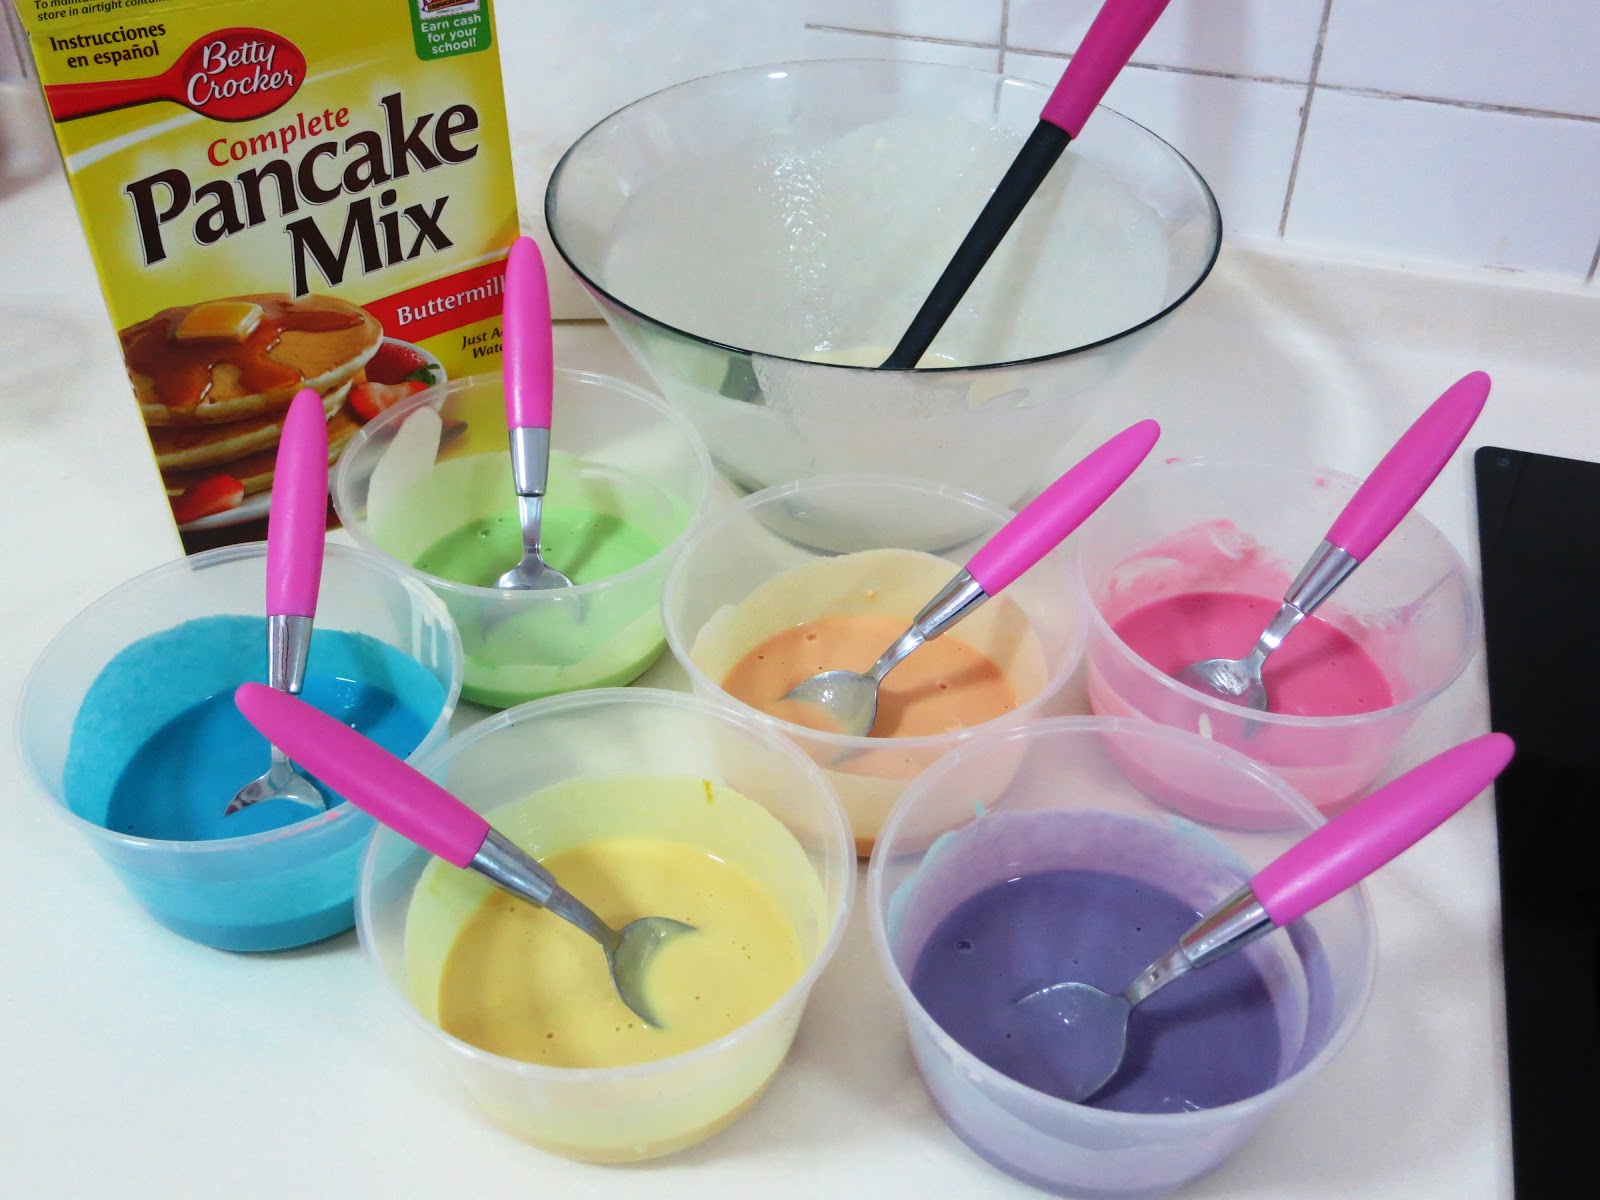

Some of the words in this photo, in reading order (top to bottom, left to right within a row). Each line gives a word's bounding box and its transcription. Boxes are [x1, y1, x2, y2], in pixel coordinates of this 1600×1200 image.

[34, 0, 48, 10] To
[37, 10, 67, 22] store
[69, 7, 79, 17] in
[81, 0, 123, 13] airtight
[49, 23, 167, 52] Instrucciones
[421, 19, 450, 33] Earn
[453, 14, 482, 27] cash
[427, 32, 446, 43] for
[449, 27, 477, 42] your
[67, 54, 89, 69] en
[94, 41, 160, 67] español
[202, 40, 276, 75] Betty
[431, 37, 477, 55] school!
[187, 65, 294, 106] Crocker
[207, 107, 351, 168] Complete
[124, 92, 480, 267] Pancake
[284, 188, 455, 299] Mix
[461, 332, 487, 350] Just
